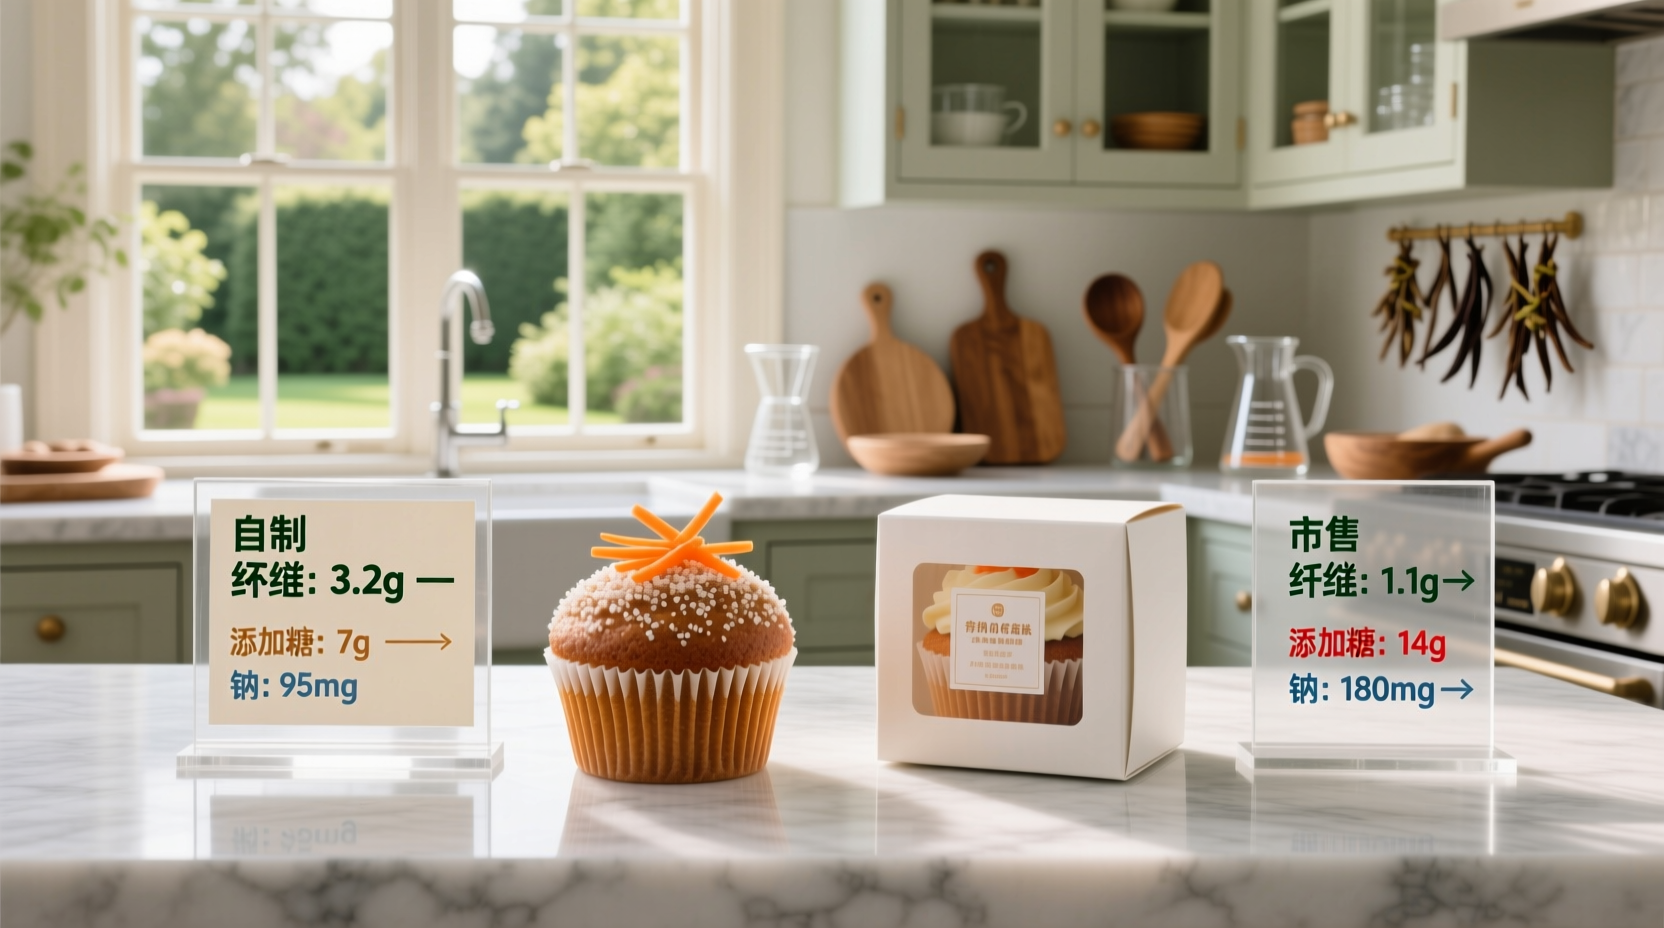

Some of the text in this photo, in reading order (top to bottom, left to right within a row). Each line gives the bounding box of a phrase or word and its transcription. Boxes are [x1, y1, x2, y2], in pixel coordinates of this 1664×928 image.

[234, 513, 307, 554] 自制
[1289, 514, 1360, 554] 市售
[329, 563, 405, 605] 3.2g
[1381, 566, 1439, 604] 1.1g
[336, 629, 370, 662] 7g
[1398, 629, 1447, 663] 14g
[279, 671, 358, 706] 95mg
[1340, 675, 1435, 710] 180mg
